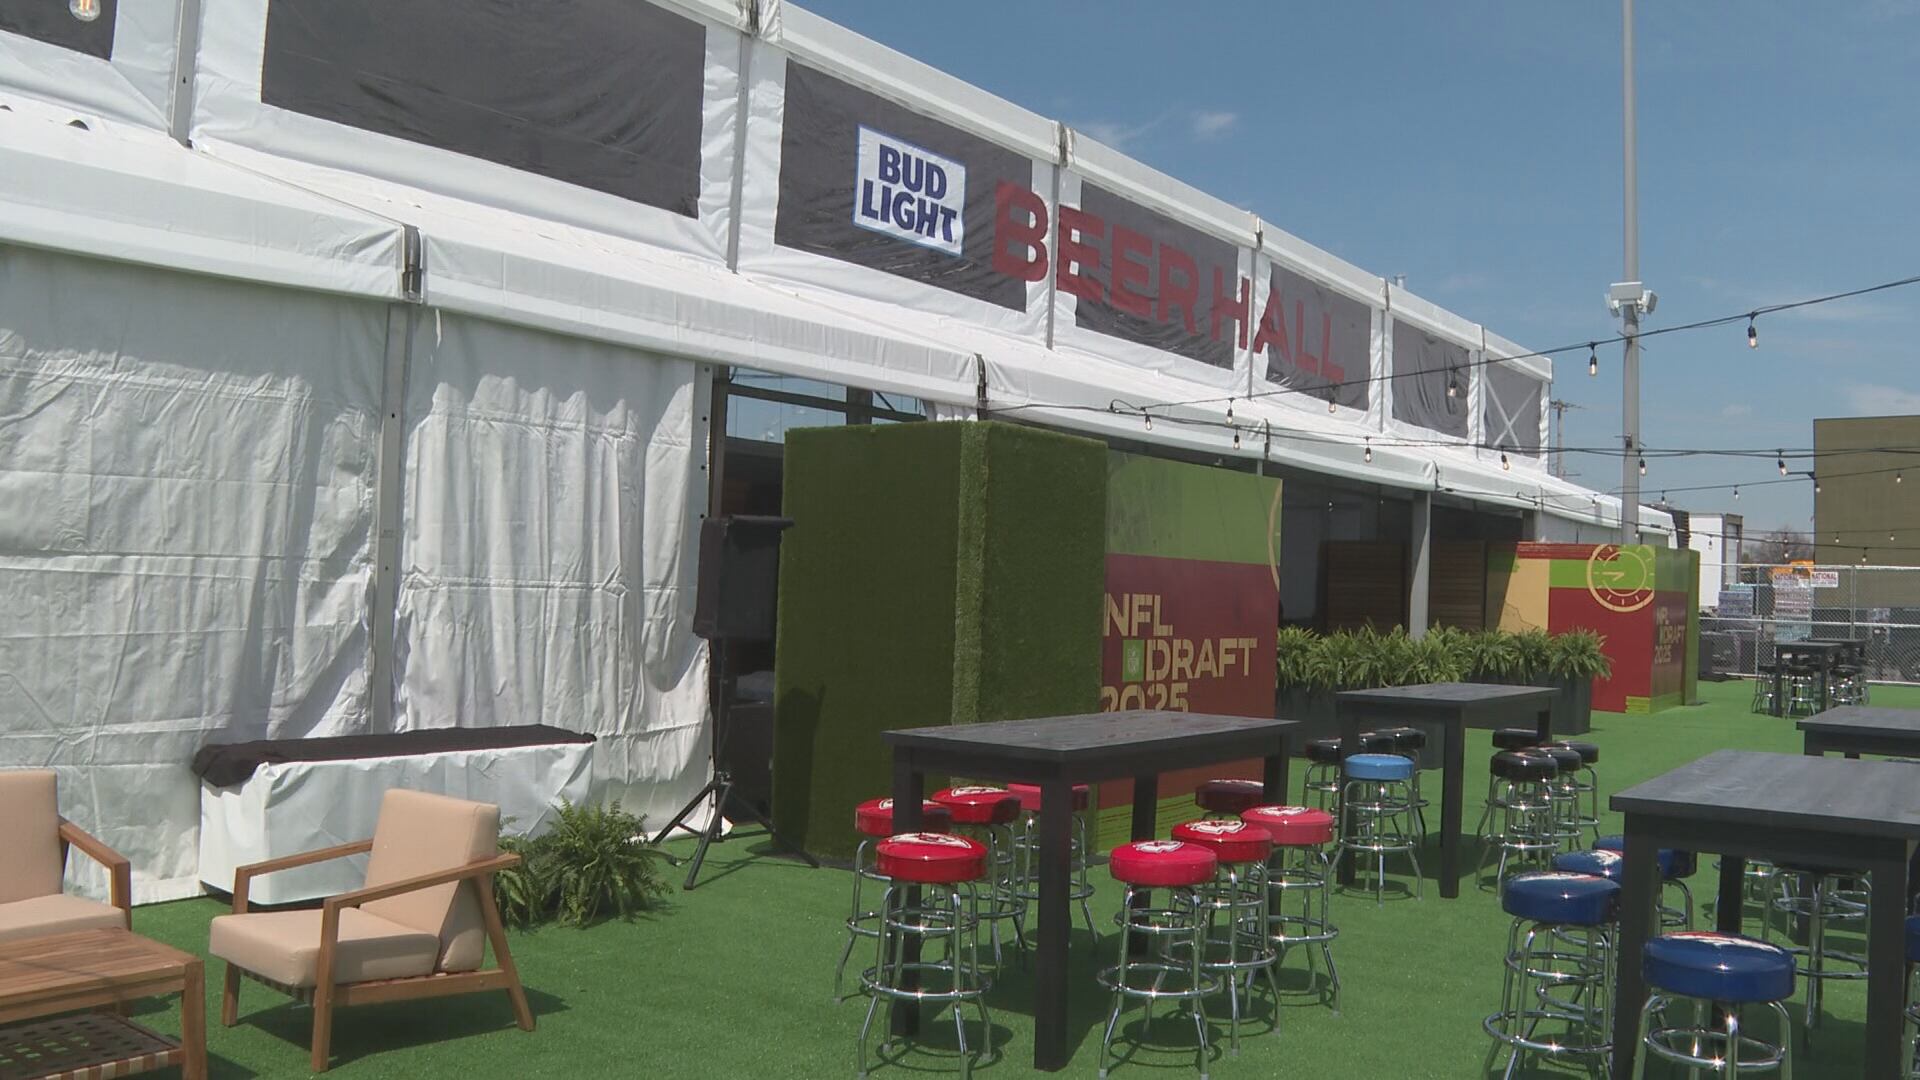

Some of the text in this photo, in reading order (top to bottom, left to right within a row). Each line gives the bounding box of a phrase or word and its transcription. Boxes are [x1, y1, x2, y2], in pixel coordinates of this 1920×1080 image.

[879, 143, 947, 200] BUD
[861, 178, 957, 243] LIGHT
[992, 181, 1345, 383] BEER HALL
[1103, 593, 1174, 637] NFL
[1145, 637, 1258, 681] DRAFT
[1101, 682, 1190, 713] 2025
